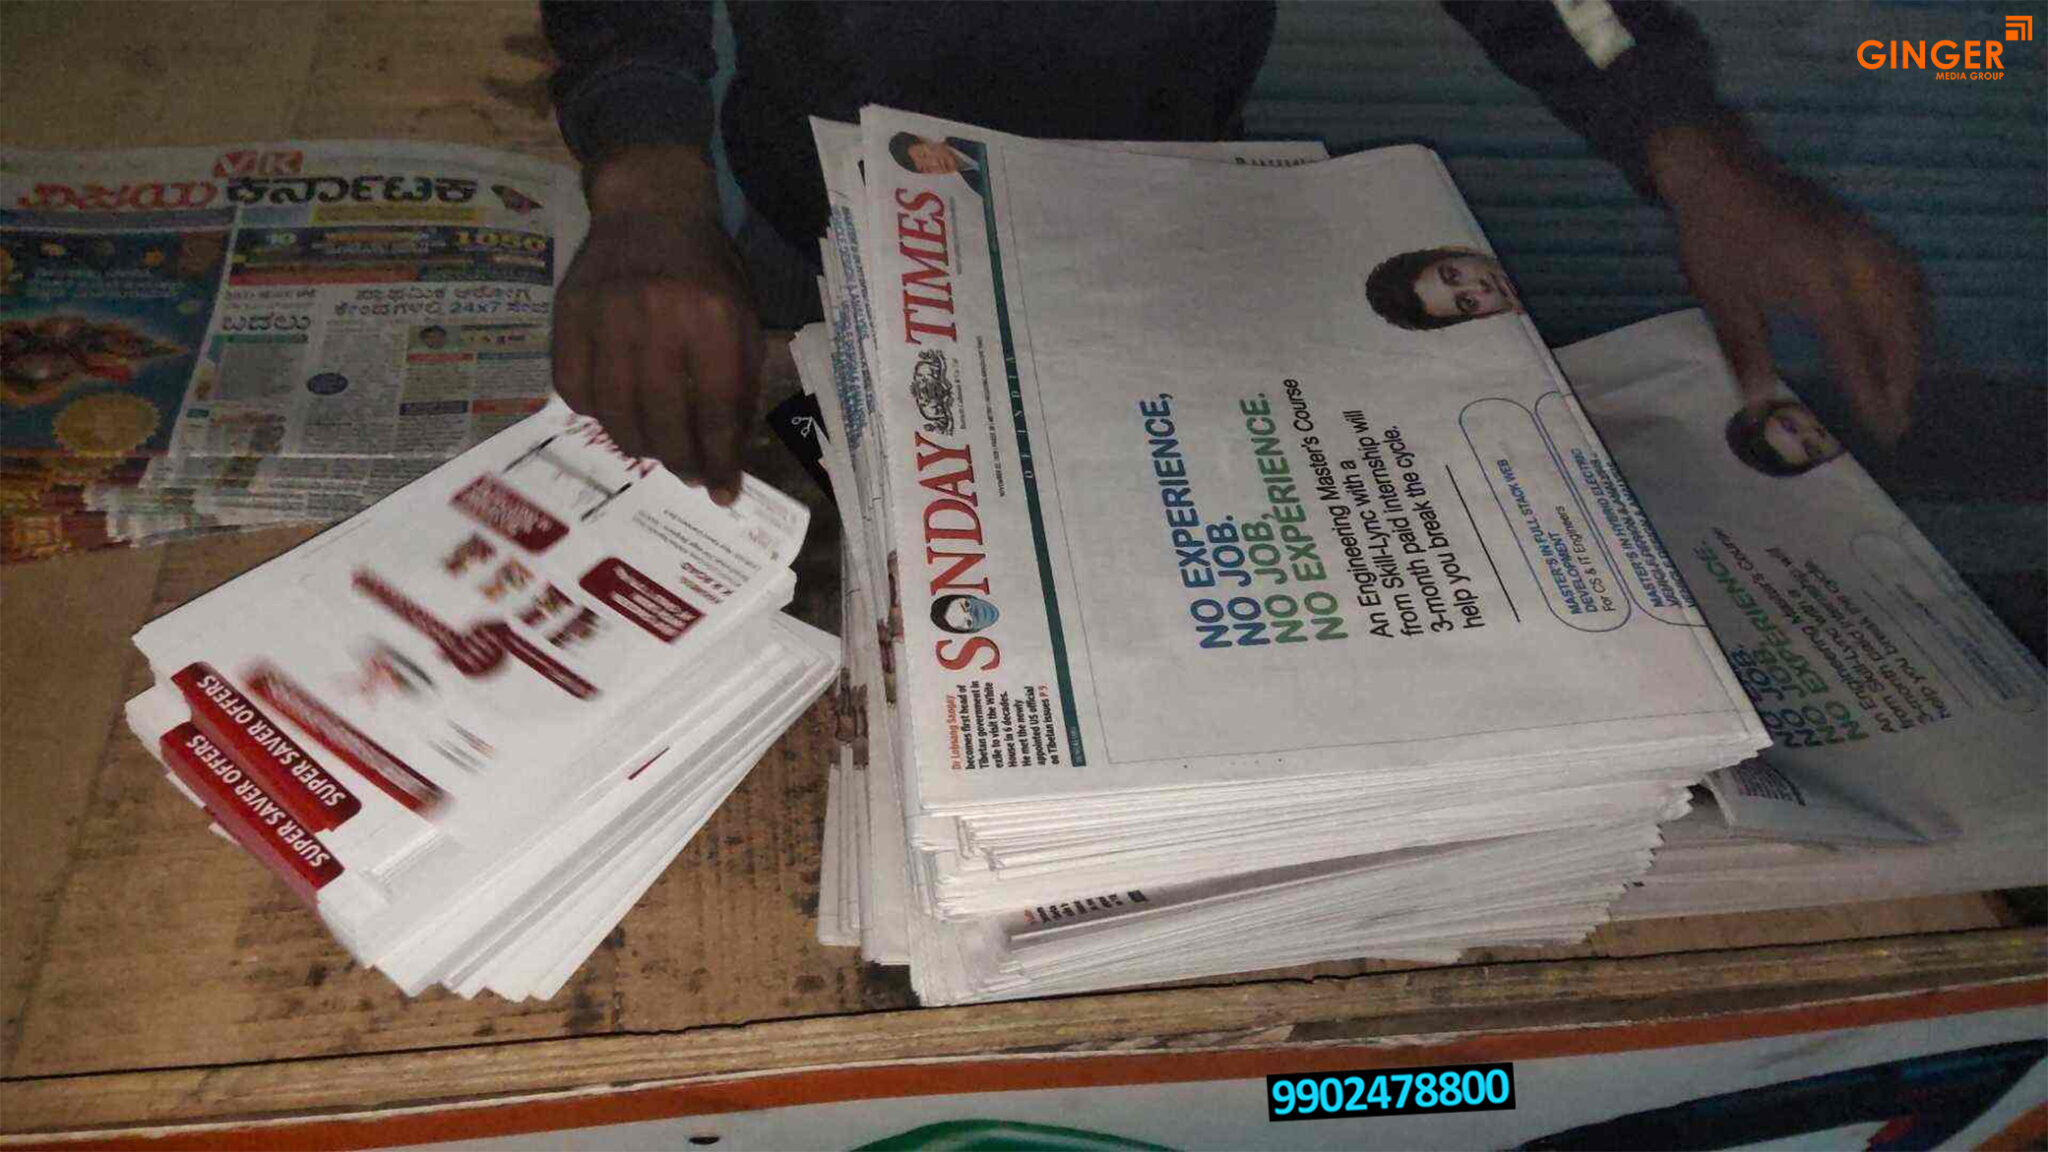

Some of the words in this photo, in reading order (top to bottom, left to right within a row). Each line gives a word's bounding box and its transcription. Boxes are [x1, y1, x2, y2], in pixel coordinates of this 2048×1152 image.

[896, 188, 958, 346] TIMES
[1283, 378, 1314, 432] Course
[1342, 409, 1370, 434] will
[1340, 459, 1357, 471] a
[1384, 425, 1415, 469] cycle.
[1240, 392, 1327, 581] EXPERIENCE.
[1300, 435, 1341, 502] Master's
[1359, 436, 1405, 514] internship
[1403, 472, 1427, 499] the
[1496, 459, 1516, 483] WEB
[1139, 392, 1216, 588] EXPERIENCE,
[1342, 474, 1371, 507] with
[1507, 483, 1533, 516] STACK
[1386, 516, 1426, 555] paid
[1412, 500, 1450, 551] break
[1527, 516, 1549, 543] FULL
[1555, 505, 1587, 554] Engineers
[915, 431, 1001, 671] SNDAY
[1205, 514, 1252, 587] JOB.
[1241, 513, 1288, 585] JOB,
[1329, 505, 1382, 607] Engineering
[1360, 509, 1405, 590] Skill-Lync
[1539, 544, 1554, 557] IN
[1577, 556, 1593, 565] IT
[1438, 553, 1472, 585] you
[1546, 558, 1584, 615] MASTER'S
[1547, 531, 1599, 613] DEVELOPMENT
[1584, 567, 1597, 576] &
[1588, 577, 1606, 594] CS
[1407, 558, 1455, 633] 3-month
[1453, 588, 1486, 629] help
[1600, 595, 1617, 612] For
[1190, 598, 1233, 649] NO
[1227, 596, 1271, 647] NO
[1264, 593, 1308, 644] NO
[1303, 591, 1349, 641] NO
[1370, 611, 1395, 638] An
[1393, 593, 1424, 638] from
[197, 674, 254, 724] OFFERS
[957, 695, 969, 714] head
[984, 682, 995, 705] White
[986, 706, 997, 720] the
[1013, 699, 1025, 723] newly
[1024, 685, 1038, 713] official
[1041, 699, 1052, 722] issues
[961, 715, 971, 732] first
[971, 690, 988, 737] government
[988, 721, 999, 739] visit
[1016, 725, 1027, 738] the
[1028, 714, 1039, 725] US
[1781, 708, 1824, 747] NO
[1801, 706, 1845, 745] NO
[1825, 701, 1870, 740] NO
[249, 720, 301, 765] SAVER
[964, 733, 976, 770] becomes
[978, 738, 989, 769] Tibetan
[1007, 742, 1018, 768] House
[1020, 738, 1030, 755] met
[1032, 726, 1047, 765] appointed
[1045, 723, 1057, 754] Tibetan
[185, 734, 242, 784] OFFERS
[991, 748, 1004, 769] exile
[1022, 755, 1032, 768] He
[234, 779, 287, 826] SAVER
[291, 760, 347, 807] SUPER
[276, 822, 331, 867] SUPER
